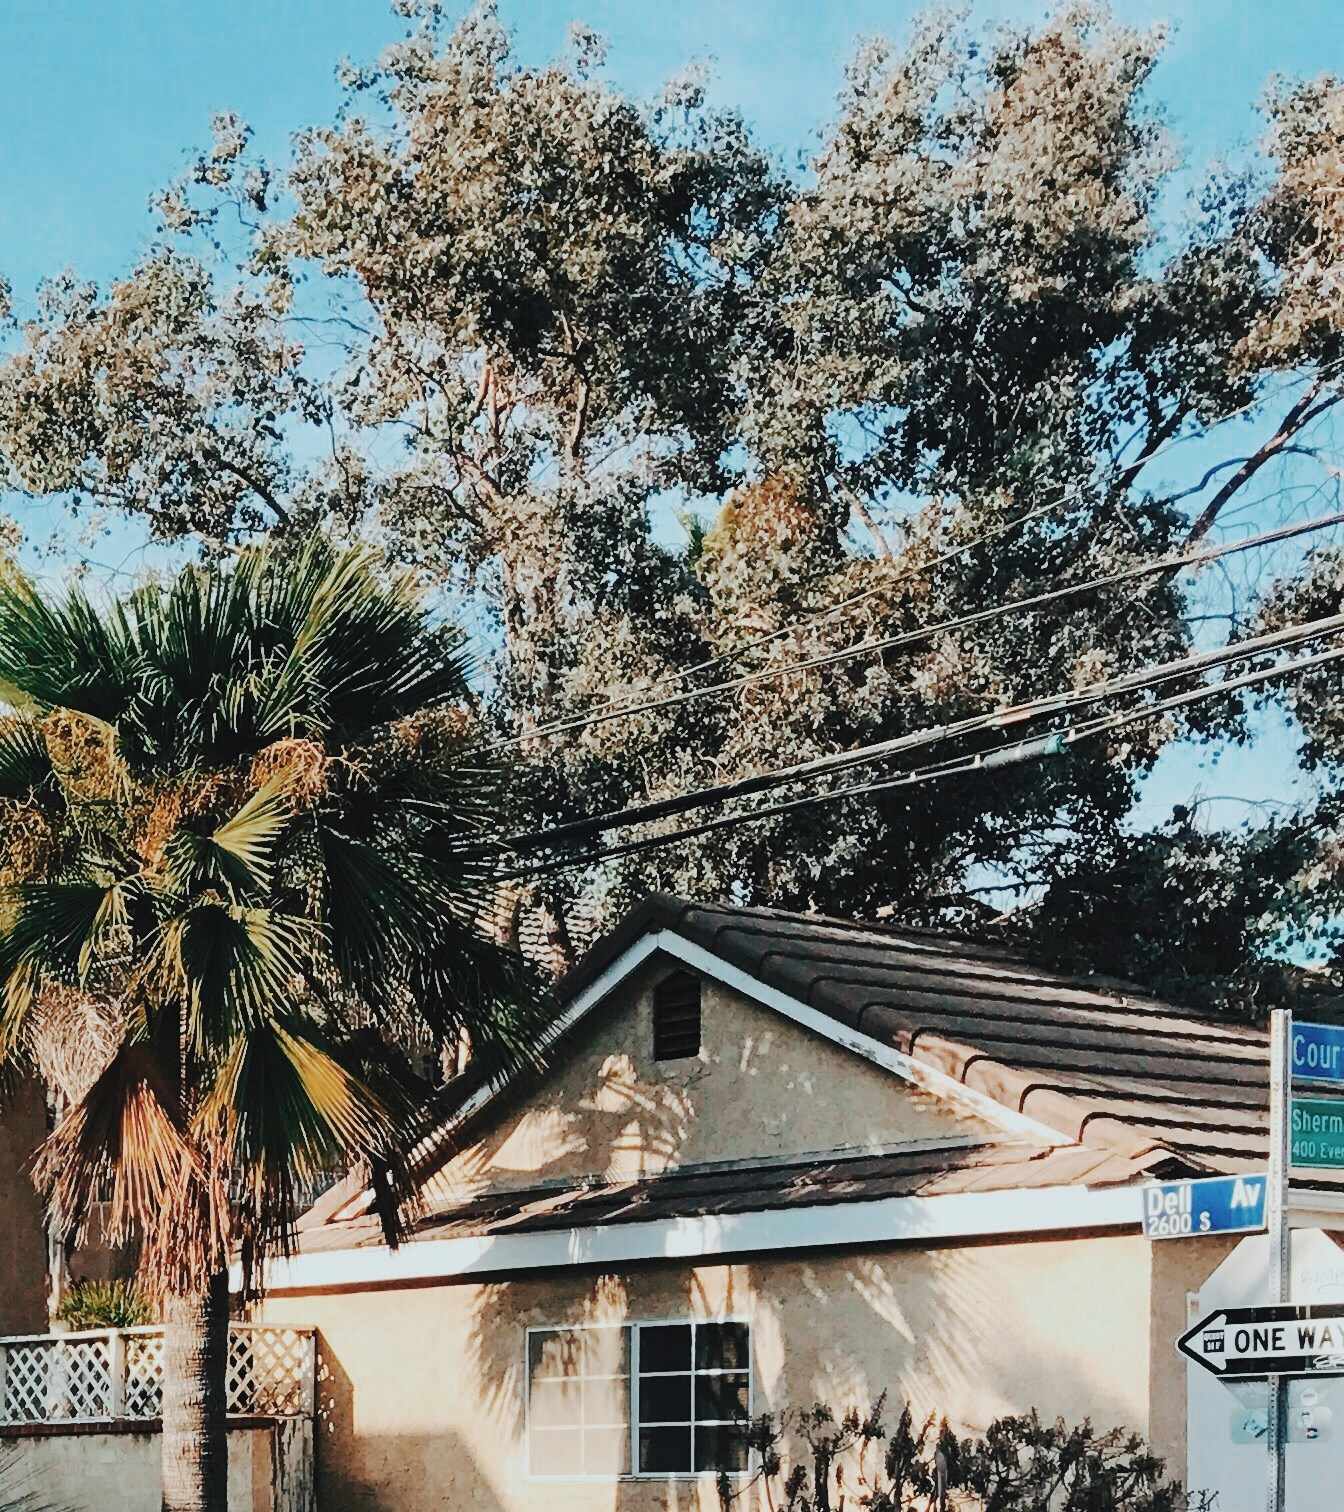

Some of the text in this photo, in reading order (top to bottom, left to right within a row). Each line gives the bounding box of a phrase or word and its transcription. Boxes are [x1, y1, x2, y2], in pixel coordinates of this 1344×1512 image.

[1293, 1034, 1344, 1069] Cour
[1292, 1108, 1344, 1134] Sherm
[1292, 1141, 1316, 1158] 400
[1148, 1179, 1261, 1216] Dell Av
[1149, 1210, 1211, 1236] 2600 S
[1234, 1327, 1286, 1353] ONE
